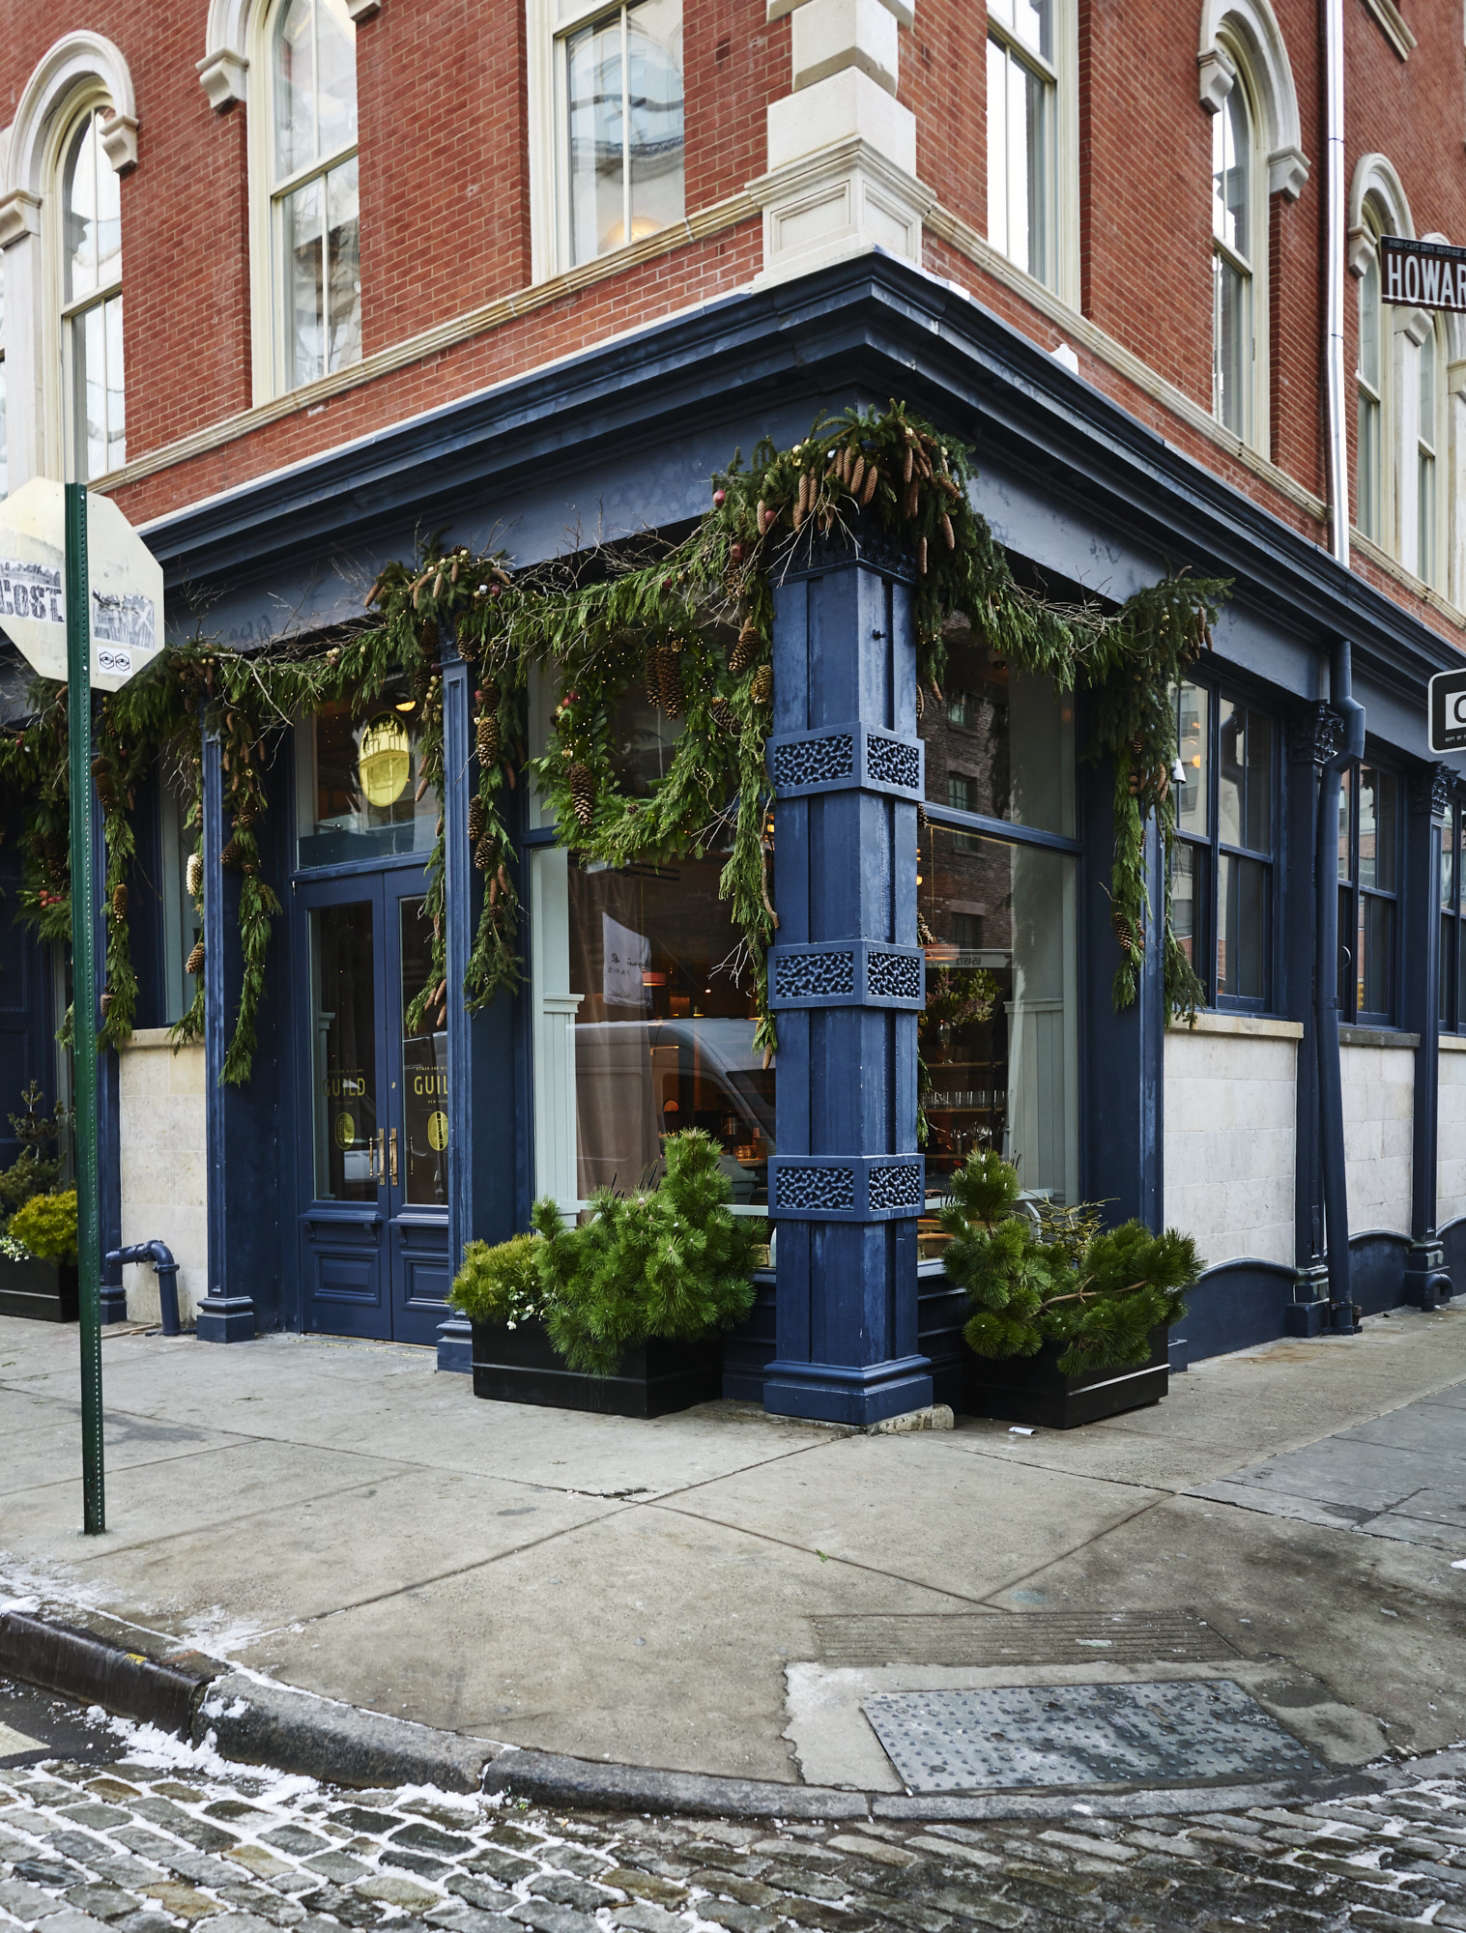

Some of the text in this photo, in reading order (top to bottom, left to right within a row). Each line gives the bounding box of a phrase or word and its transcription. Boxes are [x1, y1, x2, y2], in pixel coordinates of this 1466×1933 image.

[1387, 253, 1466, 308] HOWAR
[322, 1077, 366, 1097] UILD
[414, 1075, 448, 1095] GUIL
